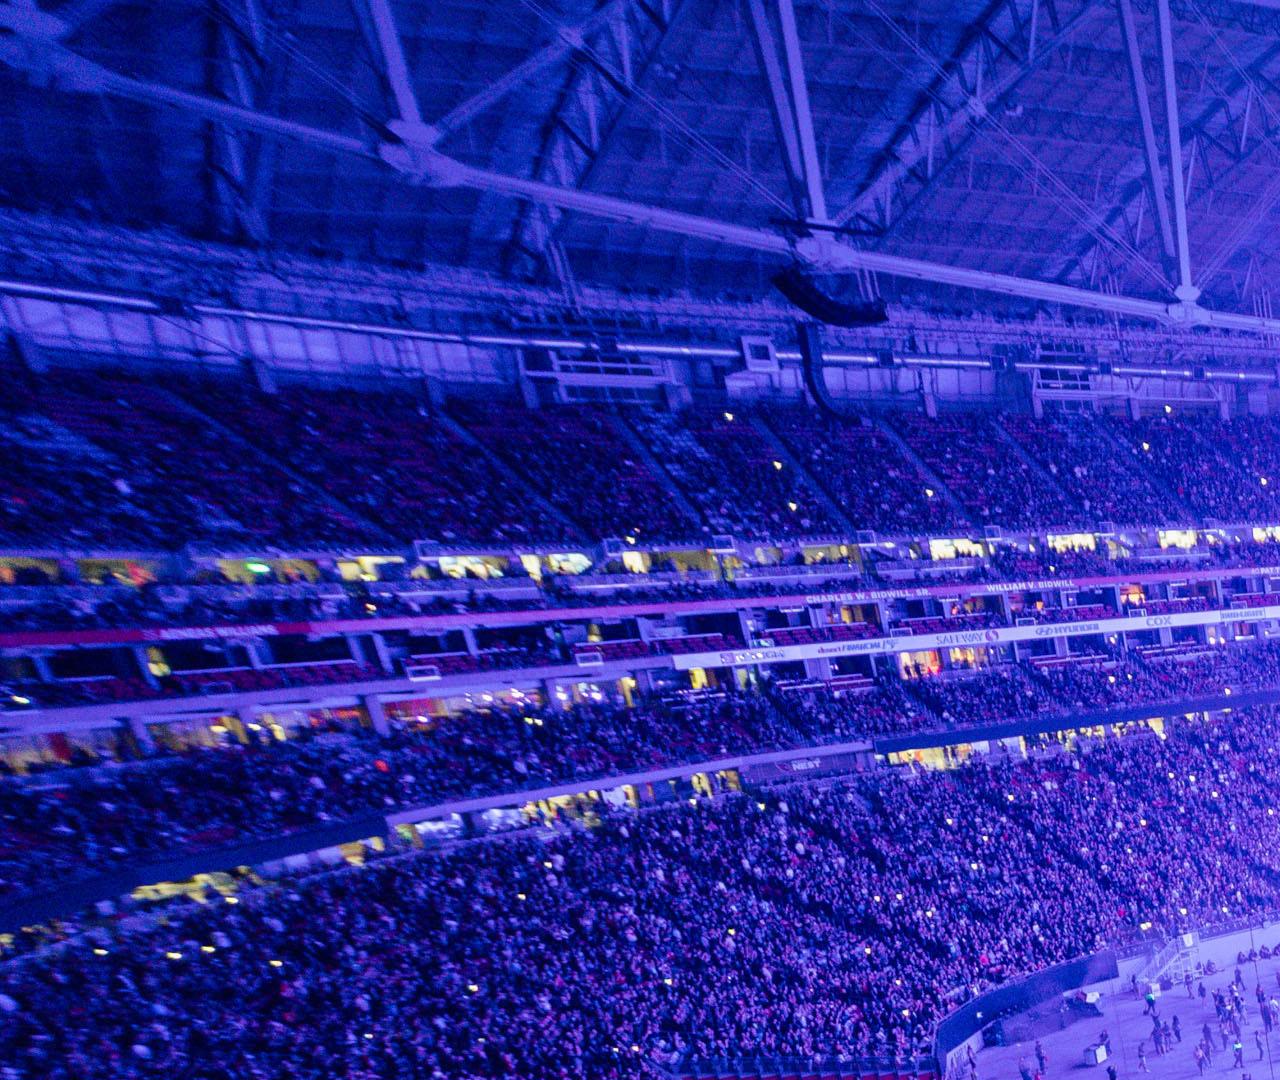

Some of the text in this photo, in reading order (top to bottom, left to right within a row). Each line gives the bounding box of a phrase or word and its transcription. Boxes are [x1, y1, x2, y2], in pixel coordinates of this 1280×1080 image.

[987, 582, 1026, 593] WILLIAM
[1038, 580, 1075, 589] BIDWILL
[806, 592, 853, 604] CHARLES
[1146, 616, 1172, 626] COX
[1054, 623, 1100, 634] HYUNDAI
[936, 631, 983, 645] SAFEWAY
